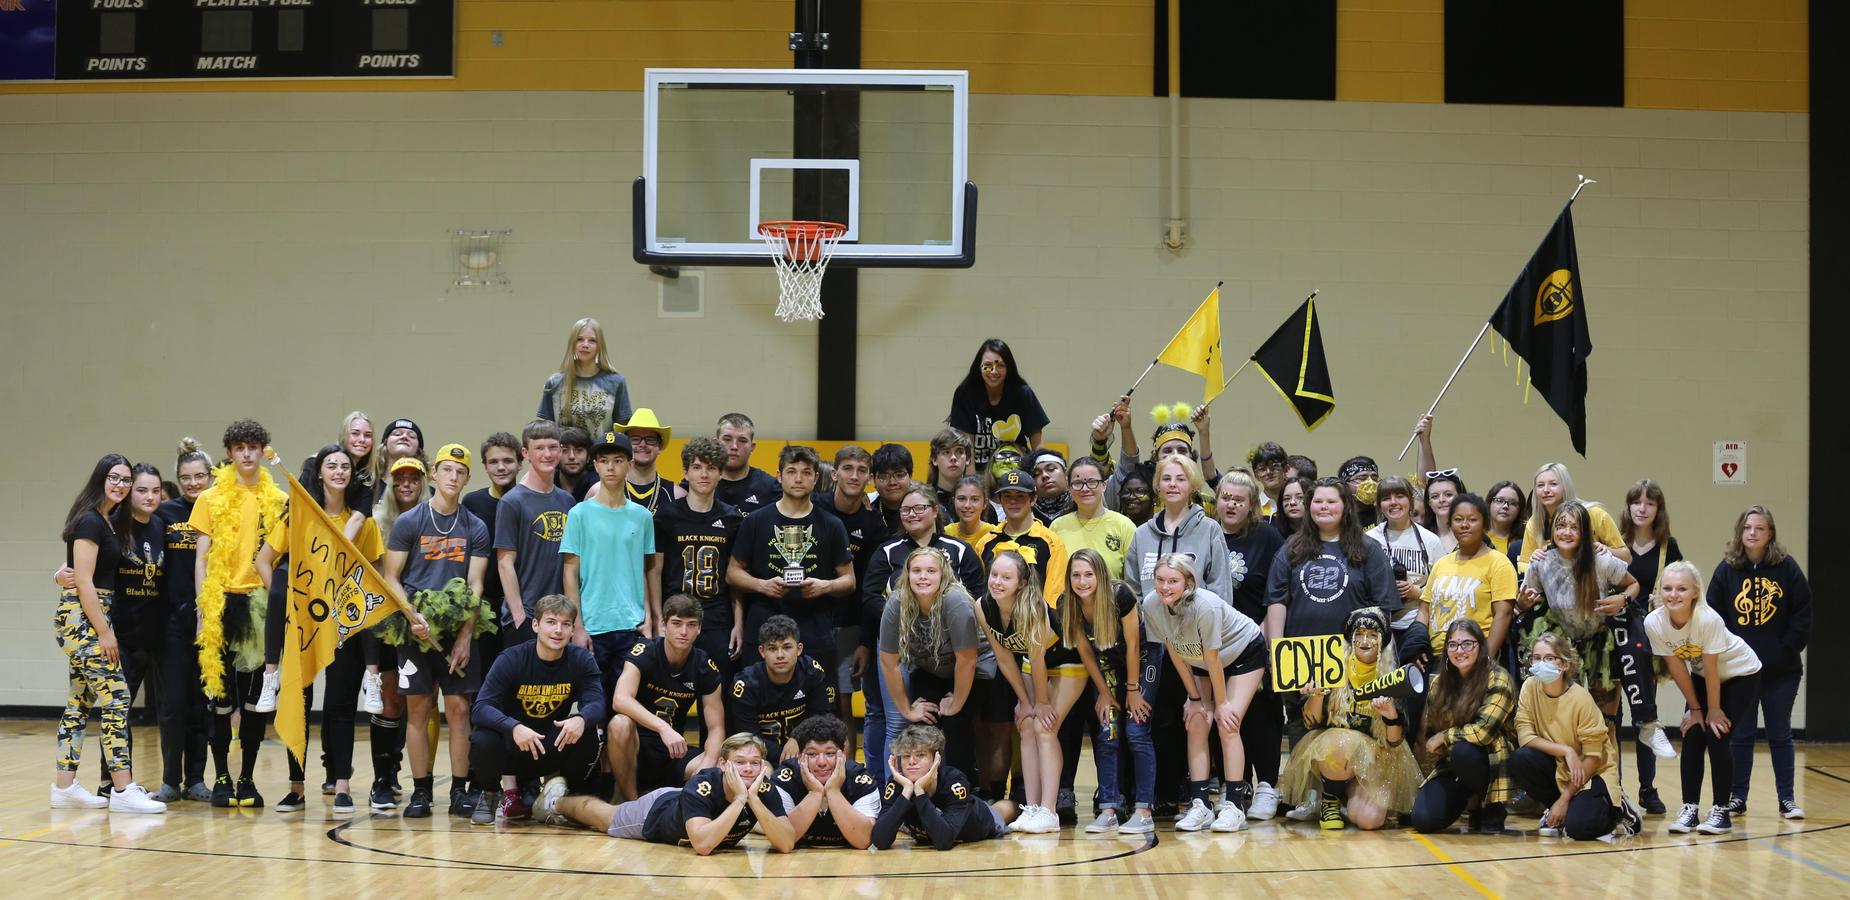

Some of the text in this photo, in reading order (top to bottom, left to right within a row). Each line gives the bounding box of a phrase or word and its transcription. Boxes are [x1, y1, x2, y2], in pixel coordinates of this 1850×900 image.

[87, 57, 147, 71] POINTS
[196, 56, 257, 70] MATCH
[358, 54, 420, 68] POINTS
[699, 535, 727, 544] KNIGHTS
[681, 544, 720, 599] 18
[1308, 564, 1340, 590] 22
[1274, 635, 1345, 690] CDHS
[518, 682, 572, 696] BLACK KNIGHTS
[647, 682, 668, 694] BLACK
[1355, 667, 1406, 697] SENIORS
